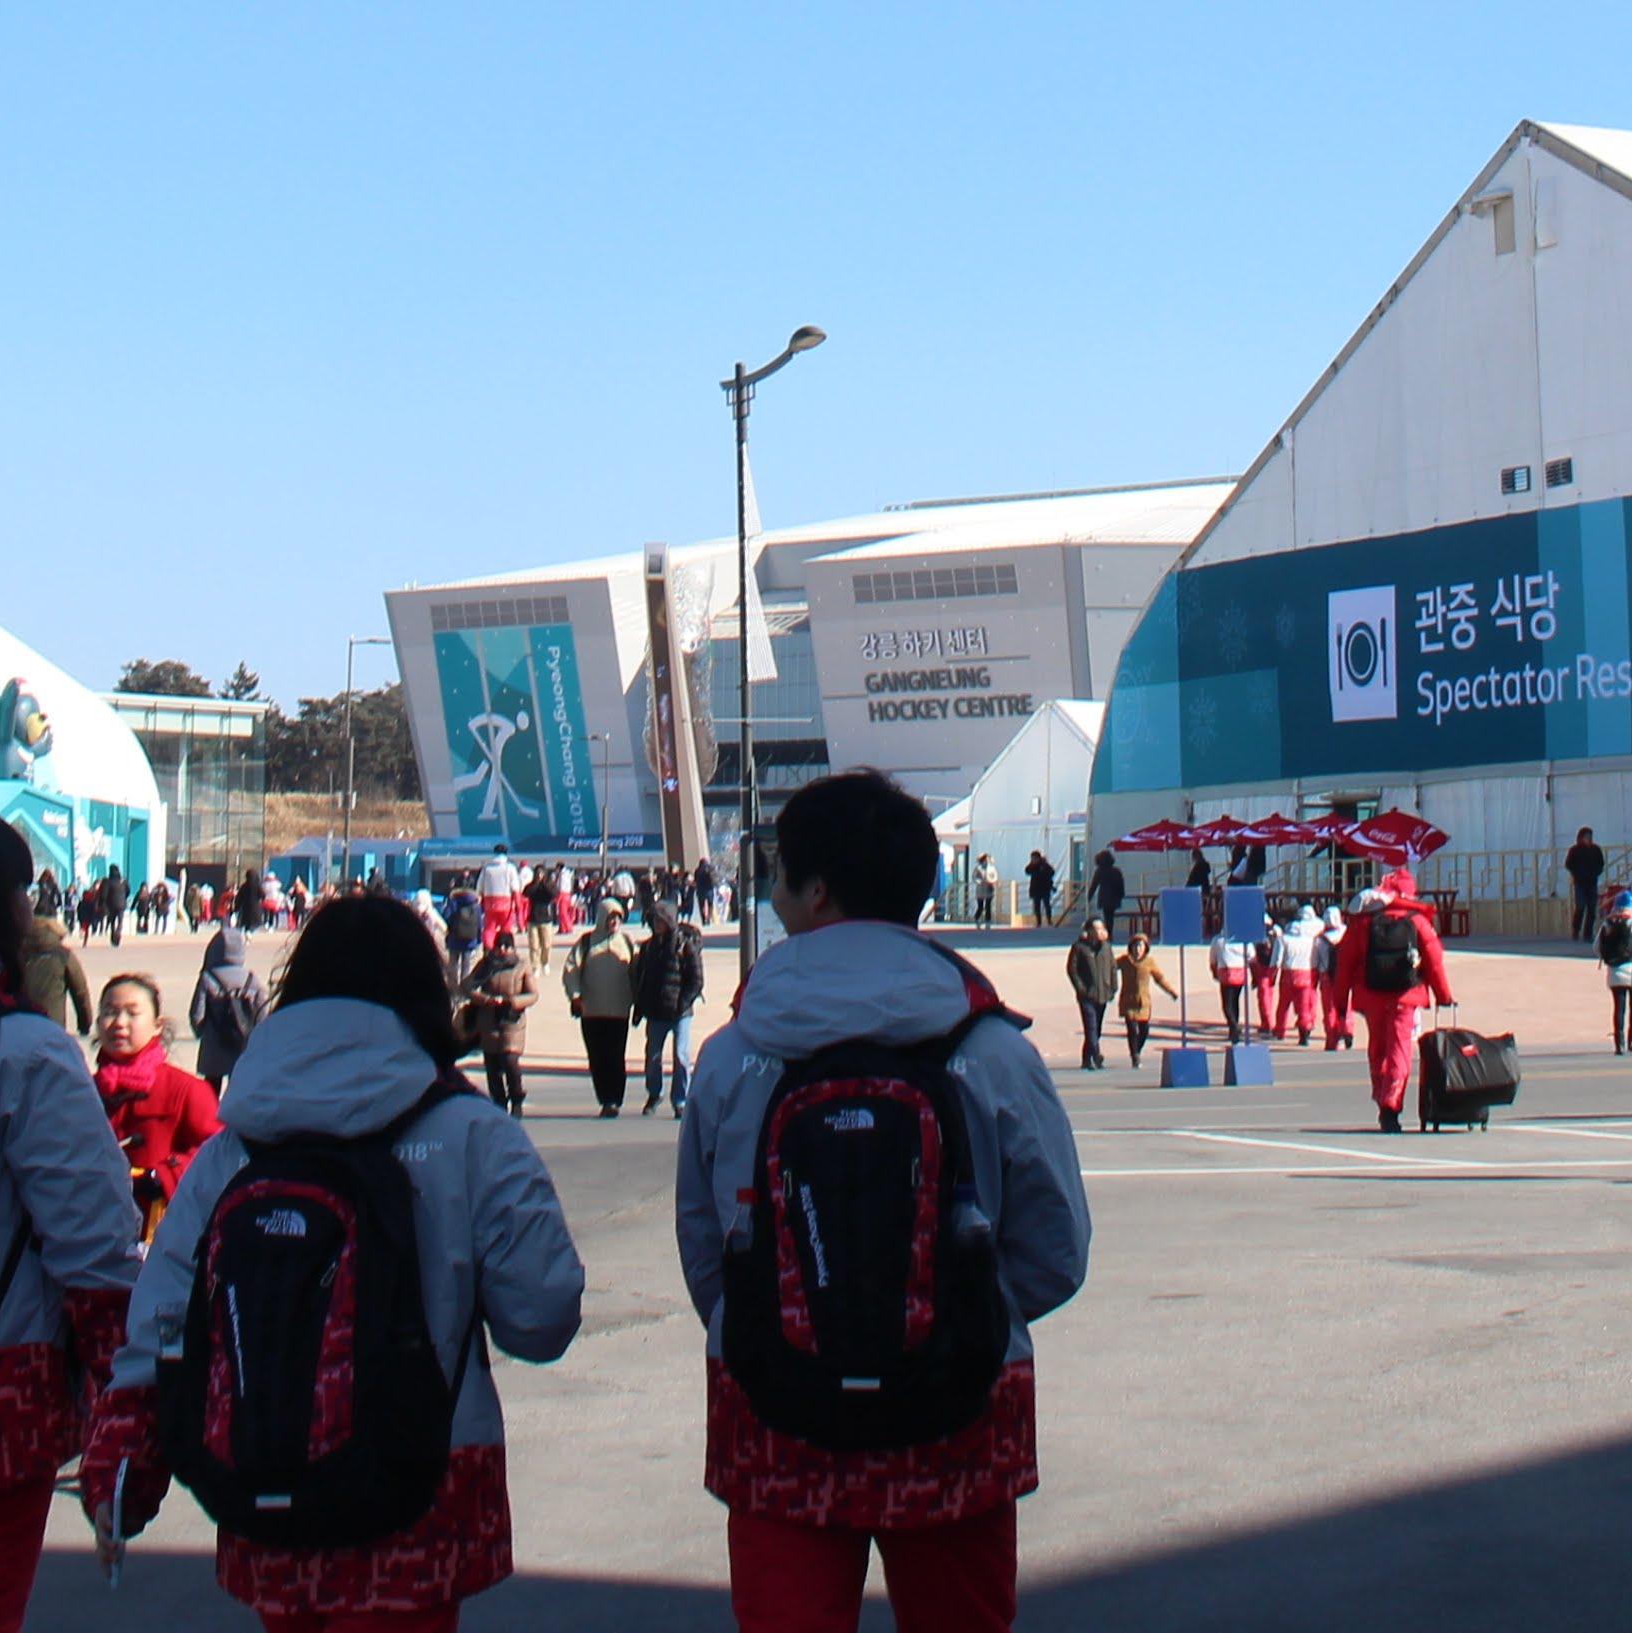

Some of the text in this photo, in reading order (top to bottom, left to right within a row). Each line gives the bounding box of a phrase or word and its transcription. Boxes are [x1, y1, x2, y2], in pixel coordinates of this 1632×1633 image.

[1415, 570, 1560, 653] 관중 식당
[860, 626, 988, 660] 강릉 하키 센터
[865, 667, 991, 693] GANGNEUNG
[1416, 662, 1569, 726] Spectator
[546, 645, 577, 787] PyeongChang
[868, 694, 1034, 723] HOCKEY CENTRE
